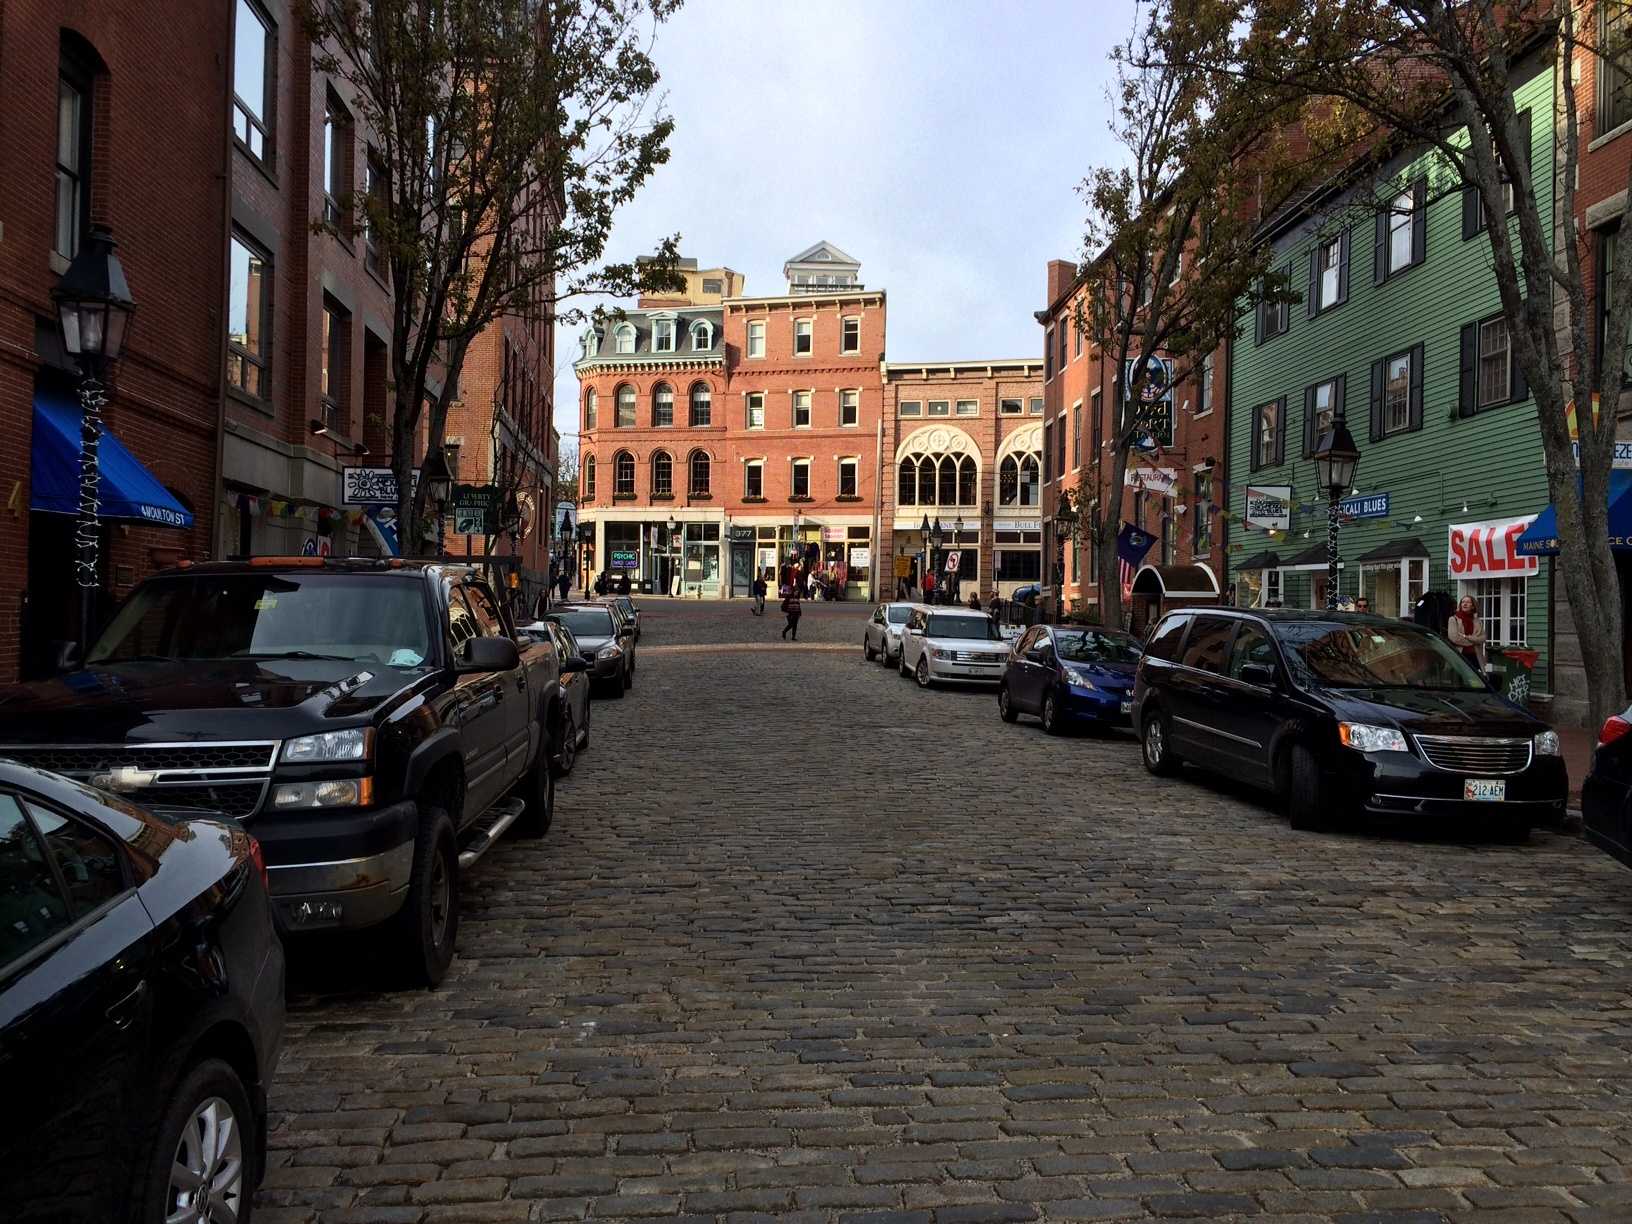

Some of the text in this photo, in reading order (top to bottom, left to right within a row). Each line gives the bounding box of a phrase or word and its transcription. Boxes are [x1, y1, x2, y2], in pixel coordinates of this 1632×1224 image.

[1342, 498, 1386, 515] ICALI BLUES
[735, 530, 752, 538] 377
[613, 552, 636, 560] PSYCHIC
[1472, 784, 1504, 796] 212 AEM
